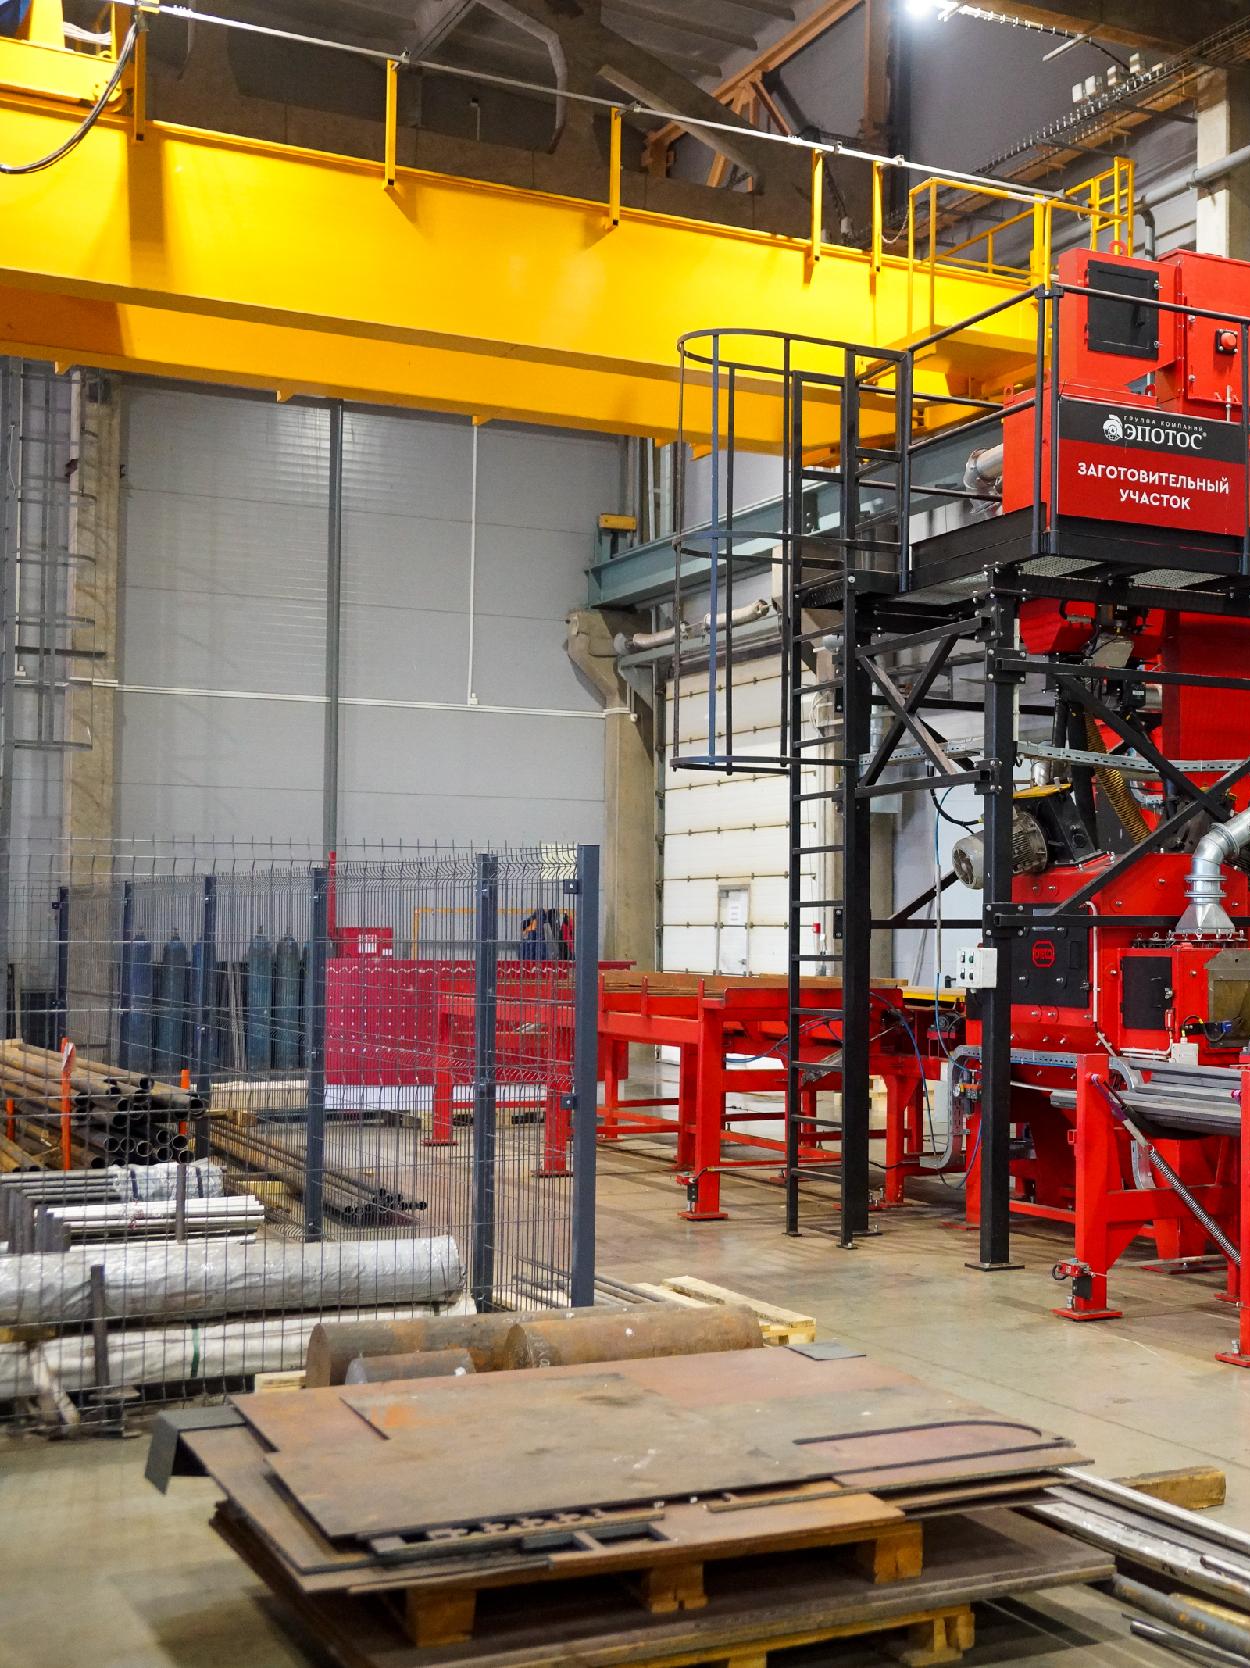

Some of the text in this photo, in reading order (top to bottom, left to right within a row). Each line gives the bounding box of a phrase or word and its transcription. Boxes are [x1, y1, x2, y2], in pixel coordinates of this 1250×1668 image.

[1124, 423, 1203, 450] ЭПОТОС
[1077, 462, 1229, 495] ЗАГОТОВИТЕЛЬНЫЙ
[1119, 488, 1191, 510] УЧАСТОК
